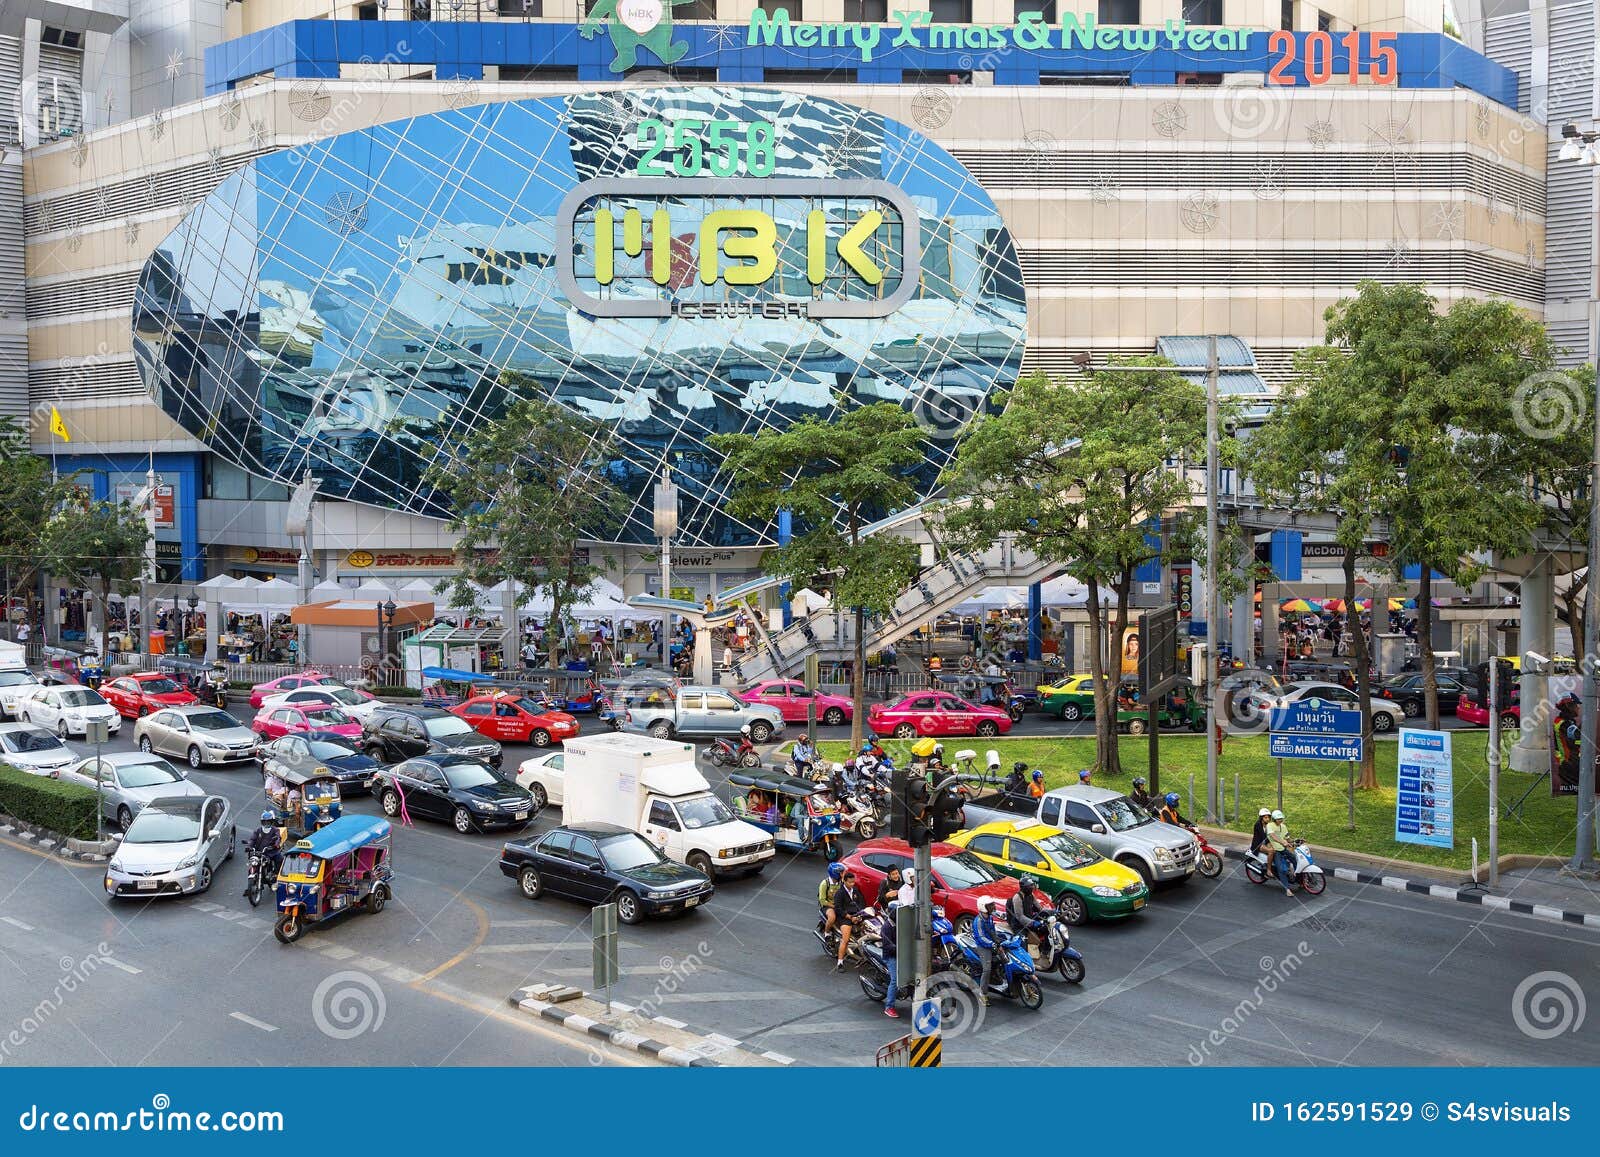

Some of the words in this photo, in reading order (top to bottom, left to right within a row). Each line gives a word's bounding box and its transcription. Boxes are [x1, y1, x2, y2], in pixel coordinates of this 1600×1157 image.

[747, 8, 880, 62] Merry
[892, 9, 1007, 48] X'mas
[1013, 11, 1054, 49] &
[1061, 11, 1157, 50] New
[1165, 19, 1253, 50] Year
[1268, 30, 1397, 85] 2015
[637, 119, 775, 177] 2558
[595, 208, 883, 285] MBK
[677, 301, 801, 319] CENTER
[668, 554, 713, 566] elewiz
[1296, 711, 1335, 726] ปทุมวัน
[1294, 745, 1318, 755] MBK
[1320, 747, 1358, 757] CENTER
